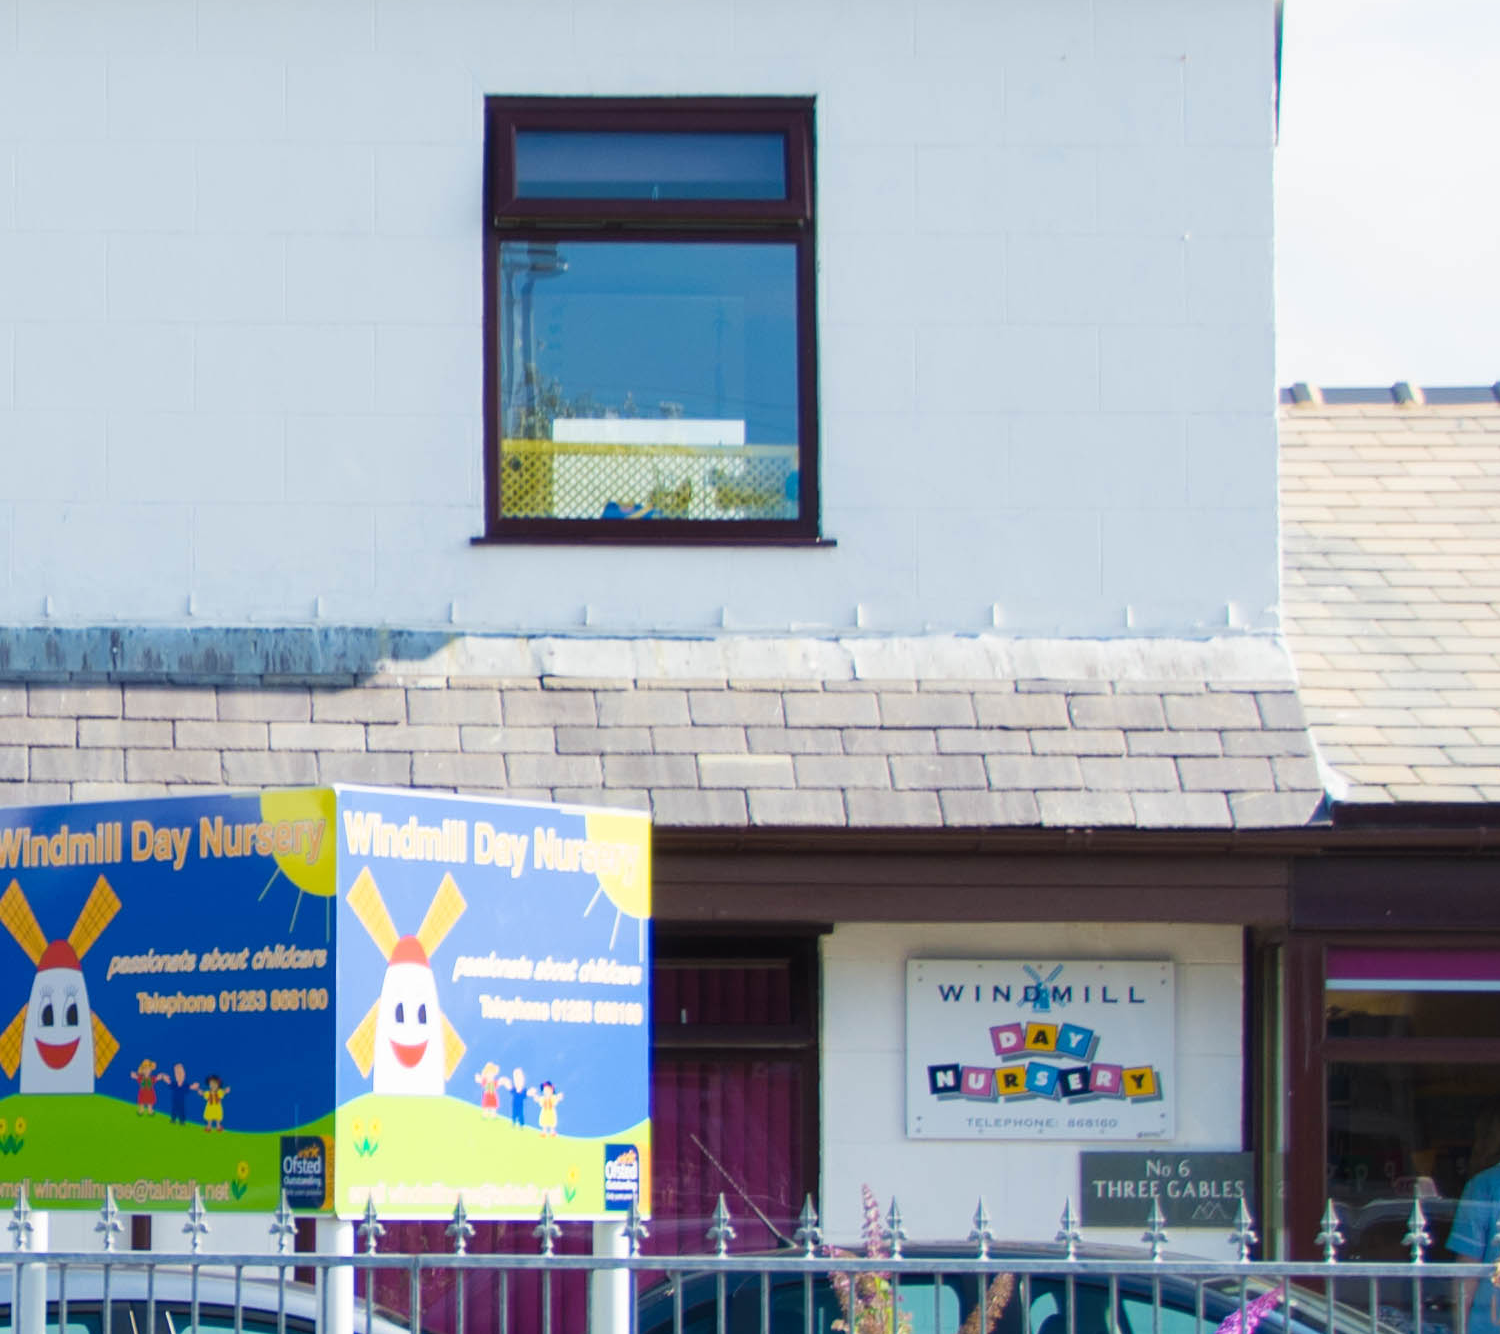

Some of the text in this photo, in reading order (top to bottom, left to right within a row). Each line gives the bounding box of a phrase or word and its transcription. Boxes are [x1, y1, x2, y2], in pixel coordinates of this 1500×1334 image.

[131, 820, 191, 870] Day
[199, 816, 327, 866] Nursery
[343, 810, 467, 863] Windmill
[474, 821, 529, 878] Day
[199, 947, 250, 972] about
[251, 944, 328, 970] childcare
[136, 991, 216, 1018] Telephone
[218, 990, 267, 1012] 01253
[938, 984, 1146, 1004] WINDMILL
[935, 1070, 1145, 1090] NURSERY
[283, 1155, 322, 1174] Ofsted
[1146, 1159, 1190, 1178] No 6
[1092, 1180, 1245, 1198] THREE GABLES
